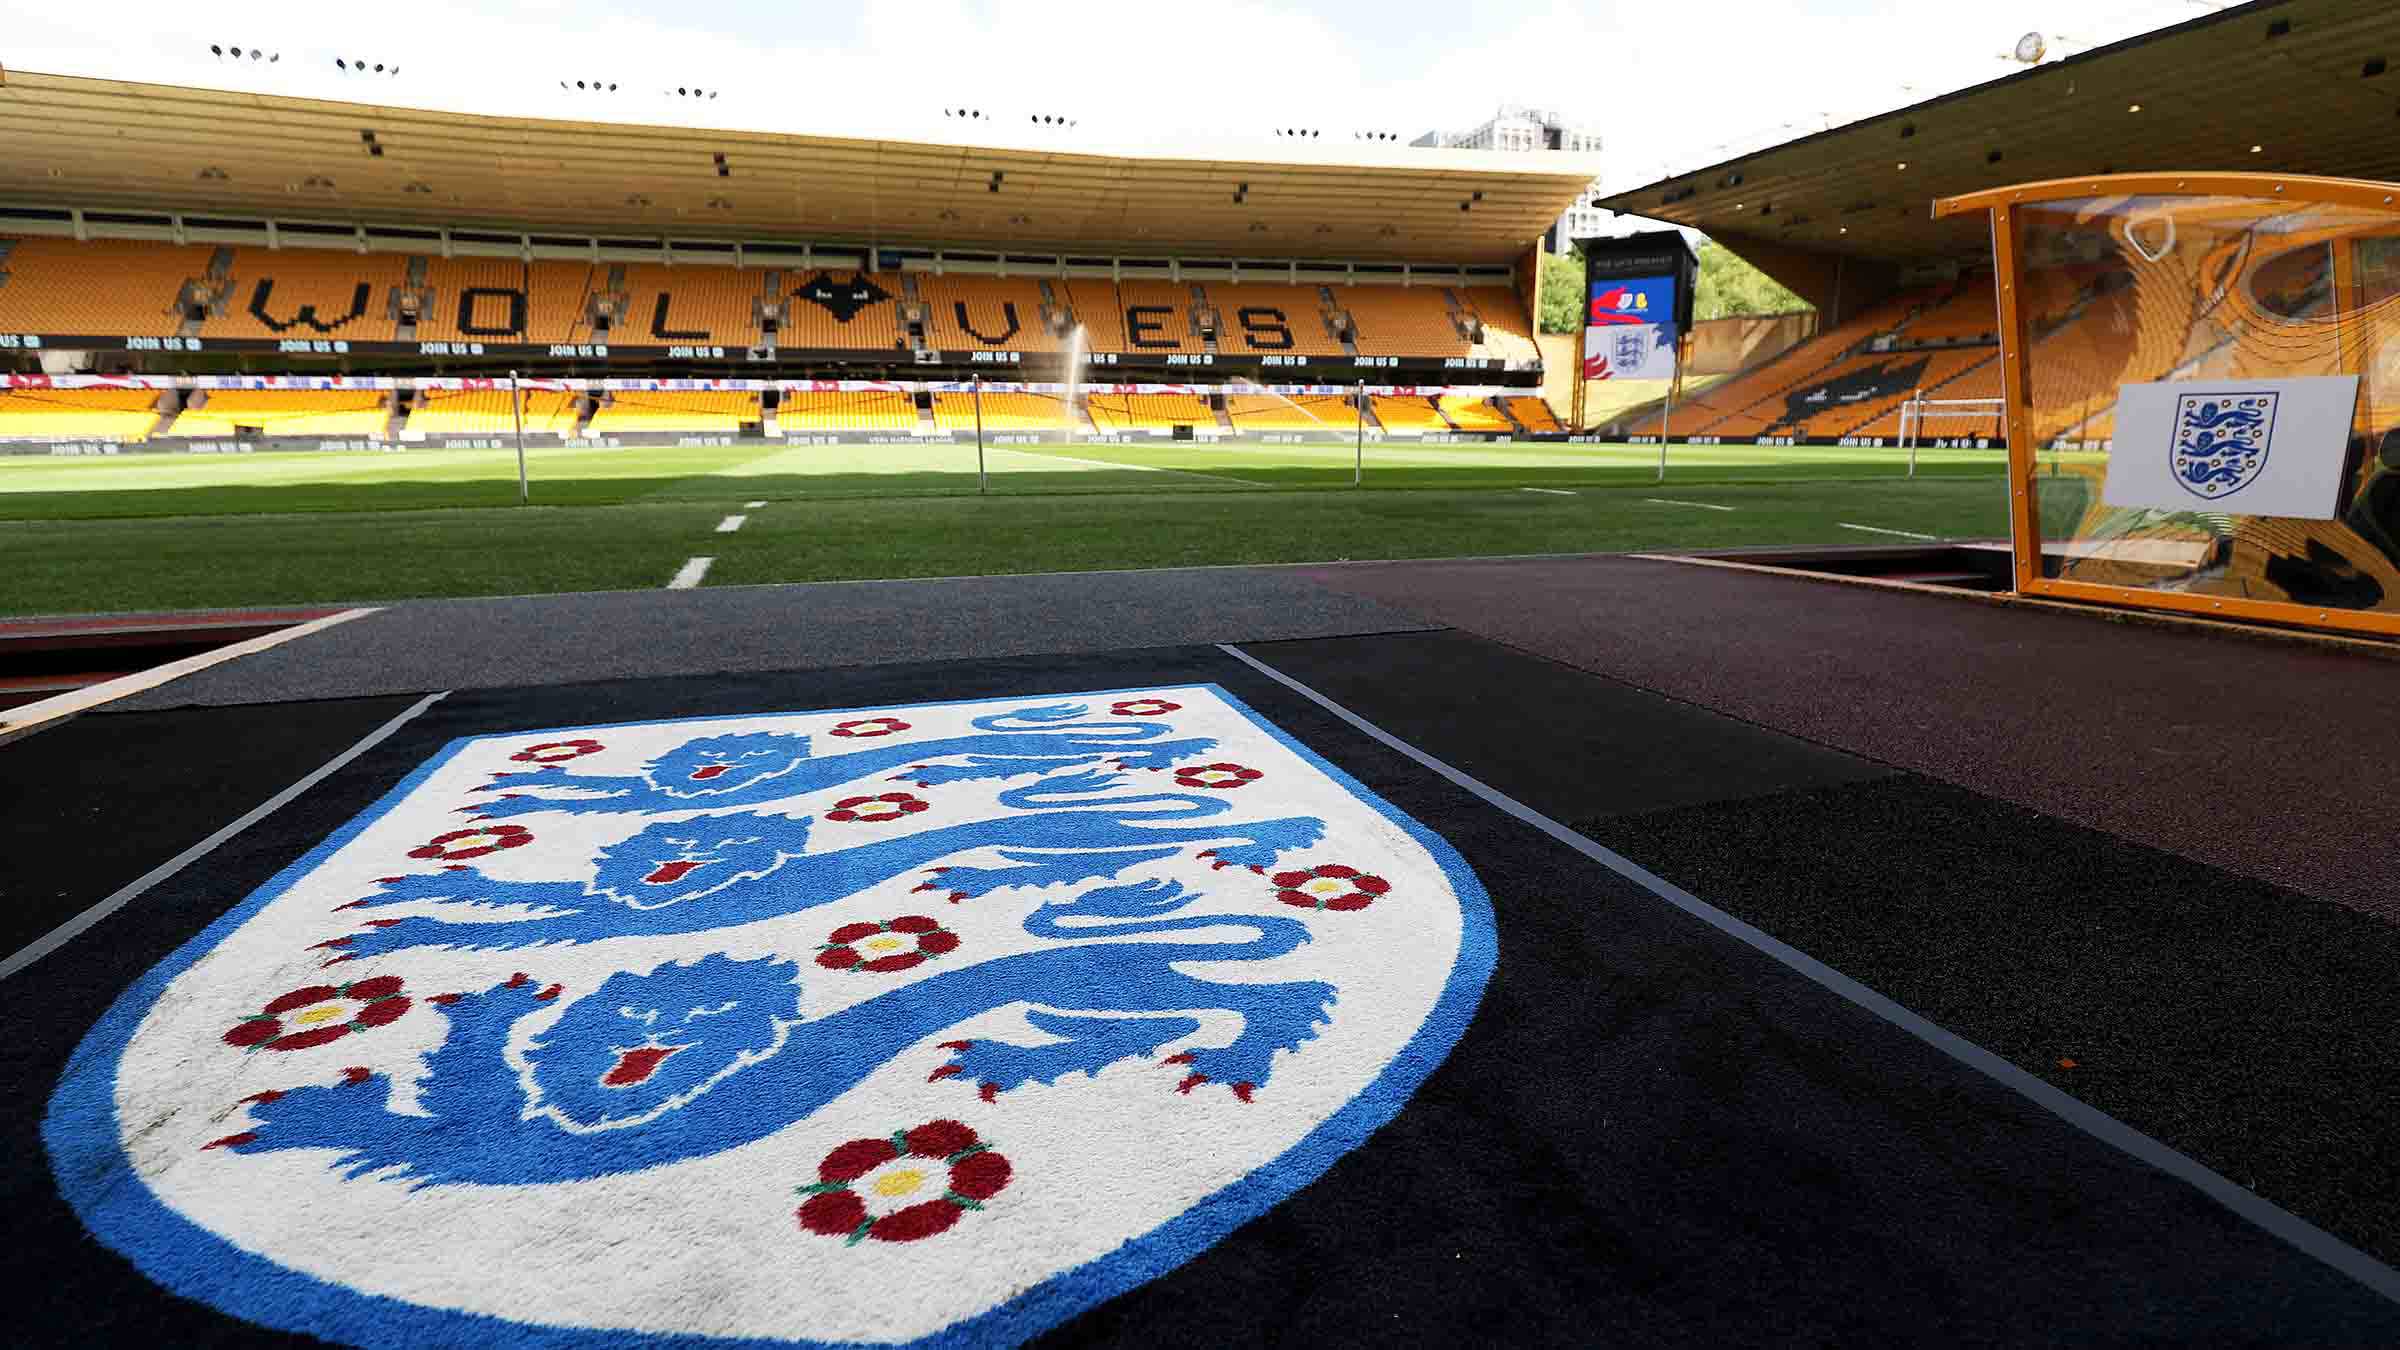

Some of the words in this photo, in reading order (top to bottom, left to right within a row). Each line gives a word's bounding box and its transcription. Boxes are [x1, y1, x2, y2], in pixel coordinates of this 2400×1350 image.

[126, 337, 161, 350] JOIN
[163, 338, 183, 351] US
[280, 341, 311, 352] JOIN
[313, 341, 331, 352] US
[419, 343, 448, 355] JOIN
[452, 343, 467, 355] US
[548, 345, 576, 357] JOIN
[578, 345, 593, 357] US
[668, 347, 693, 358] JOIN
[695, 347, 710, 358] US
[971, 352, 993, 362] JOIN
[995, 352, 1007, 362] US
[1167, 355, 1188, 365] JOIN
[1190, 355, 1201, 365] US
[1261, 356, 1282, 366] JOIN
[1284, 356, 1295, 366] US
[1354, 357, 1374, 367] JOIN
[1376, 357, 1387, 367] US
[1444, 358, 1464, 368] JOIN
[1466, 358, 1476, 368] US
[1839, 437, 1859, 446] JOIN
